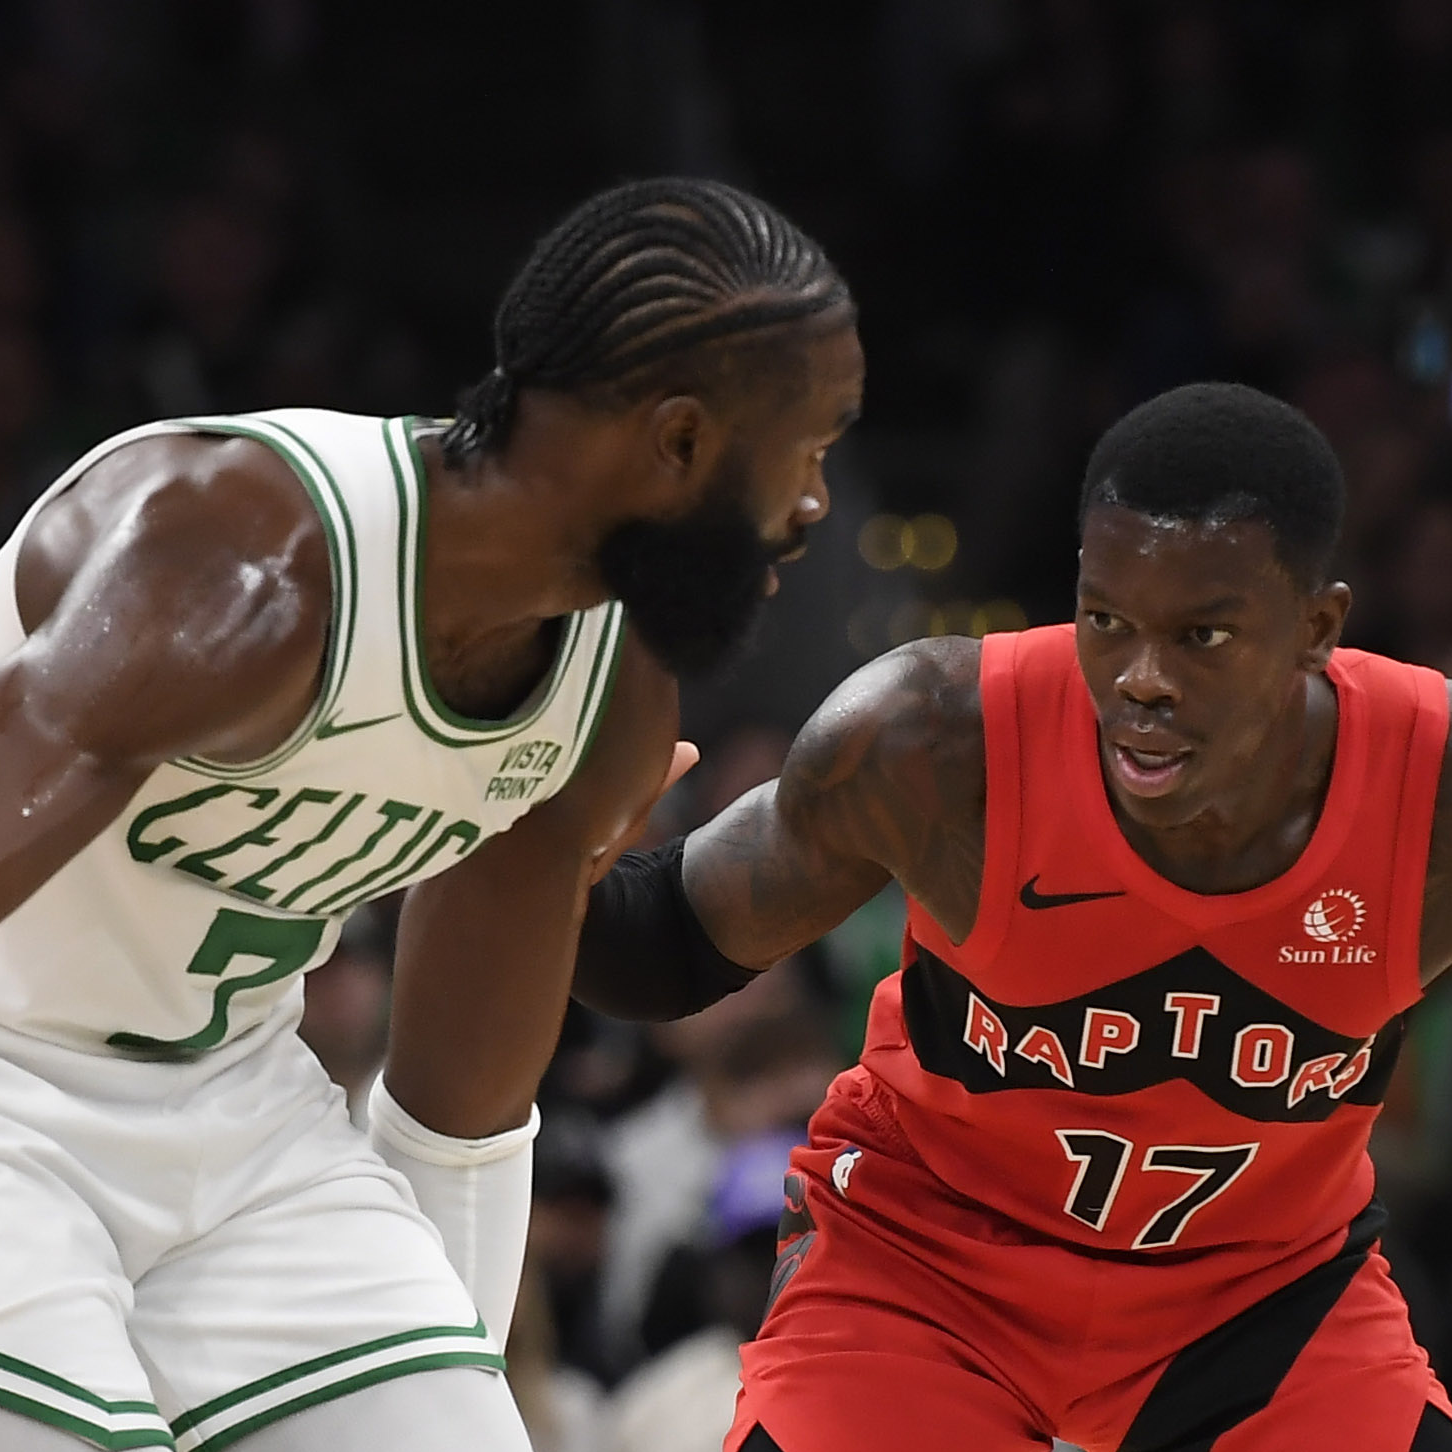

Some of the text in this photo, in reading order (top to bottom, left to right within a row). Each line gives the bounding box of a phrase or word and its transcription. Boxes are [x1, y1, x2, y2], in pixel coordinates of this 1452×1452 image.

[497, 740, 563, 775] VISTA
[484, 776, 545, 802] PRINT
[1278, 944, 1377, 964] Sun Life
[105, 908, 329, 1055] 7
[1054, 1128, 1260, 1251] 17
